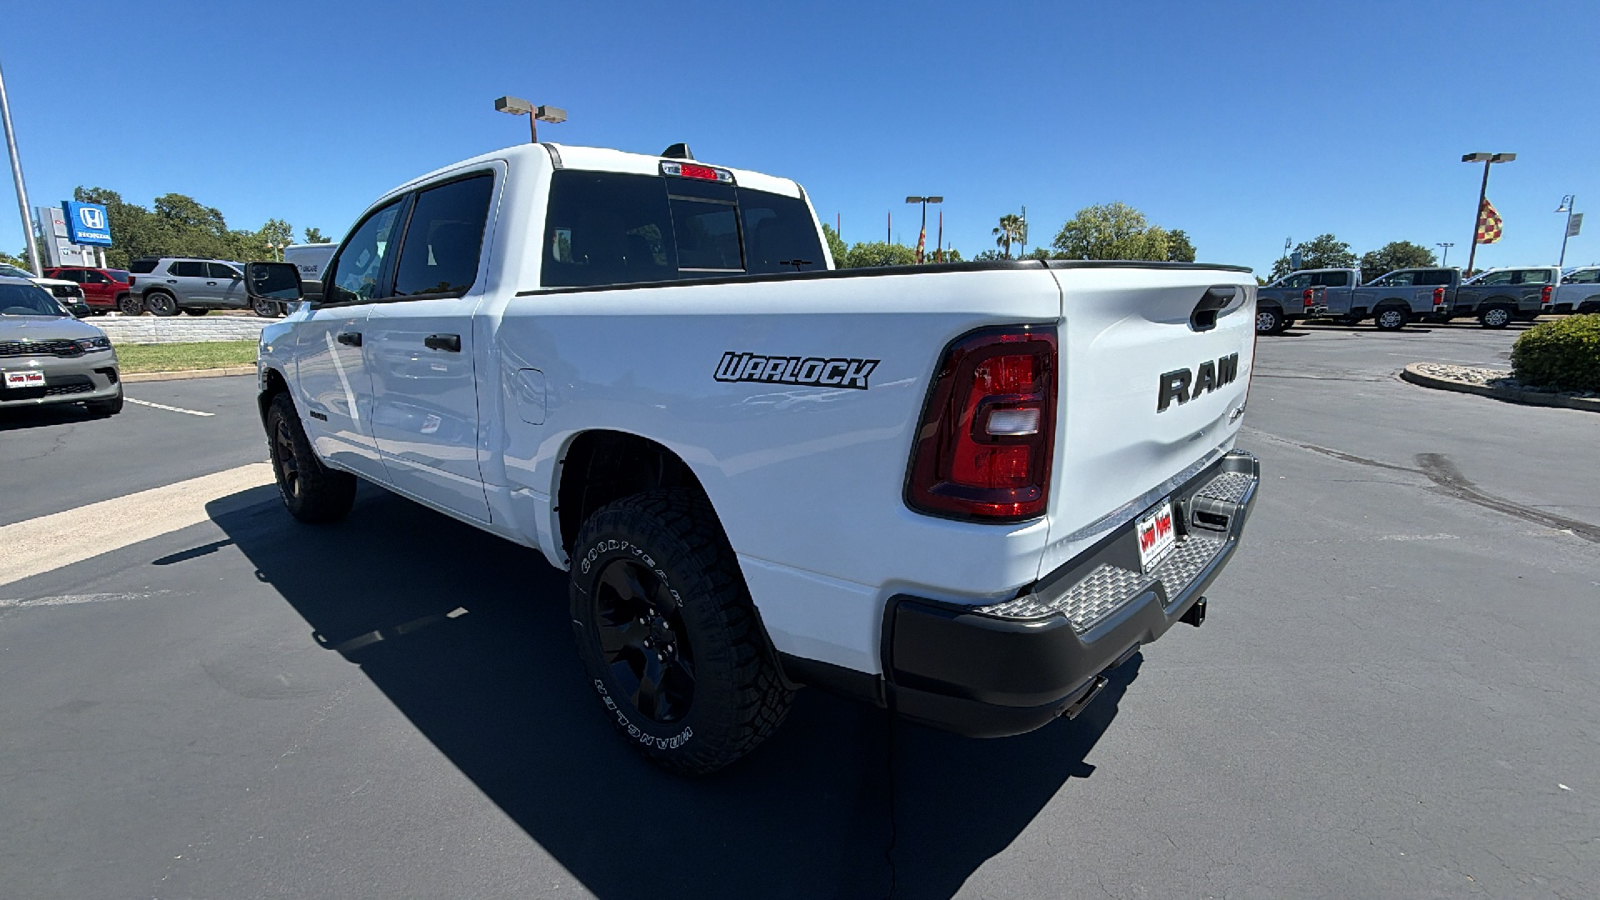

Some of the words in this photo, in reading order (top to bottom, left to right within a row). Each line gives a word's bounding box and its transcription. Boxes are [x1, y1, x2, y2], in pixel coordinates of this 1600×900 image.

[77, 231, 111, 240] HONDA
[713, 351, 881, 390] WARLOCK
[1157, 352, 1239, 413] RAM
[581, 539, 684, 608] GOODYEAR
[594, 678, 694, 750] WRANGLER
